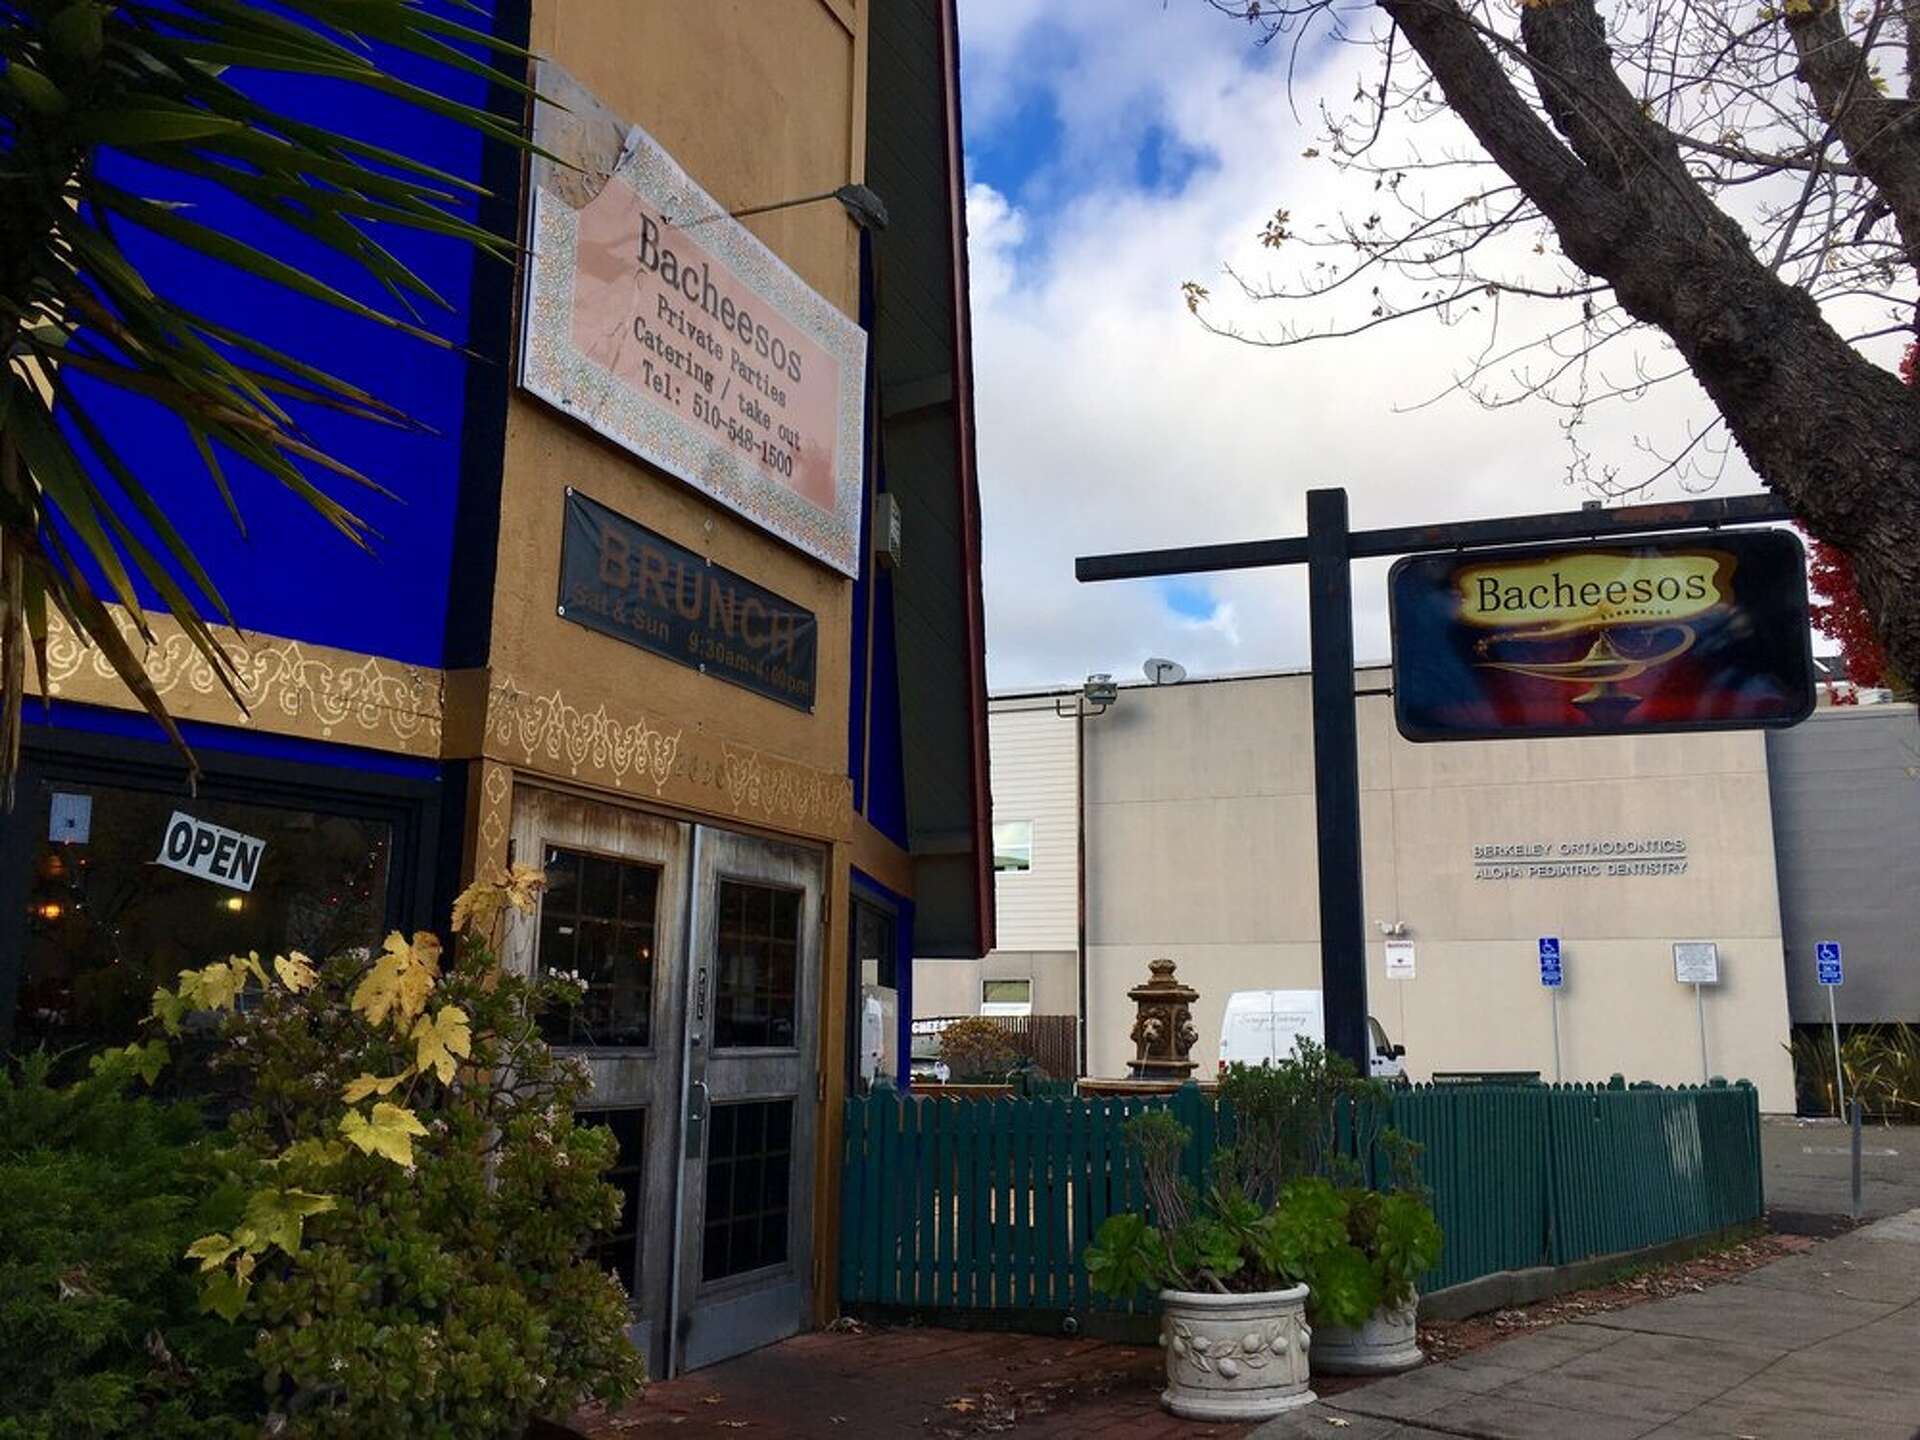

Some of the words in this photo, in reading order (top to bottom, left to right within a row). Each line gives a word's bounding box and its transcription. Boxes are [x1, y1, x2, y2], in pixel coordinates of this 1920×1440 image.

[638, 212, 802, 383] Bacheesos
[634, 316, 715, 394] Catering
[720, 378, 731, 400] /
[738, 393, 771, 431] take
[778, 423, 801, 451] out
[656, 293, 724, 362] Private
[730, 348, 787, 409] Parties
[642, 358, 682, 406] Tel:
[692, 392, 793, 478] 510-548-1500
[598, 524, 797, 664] BRUNCH
[631, 605, 671, 643] Sun
[1476, 571, 1707, 613] Bacheesos
[167, 820, 261, 885] OPEN
[1475, 844, 1552, 859] BERKELEY
[1559, 838, 1688, 856] ORTHODONTICS
[1475, 866, 1523, 880] ALOHA
[1529, 864, 1601, 878] PEDIATRIC
[1607, 862, 1689, 877] DENTISTRY
